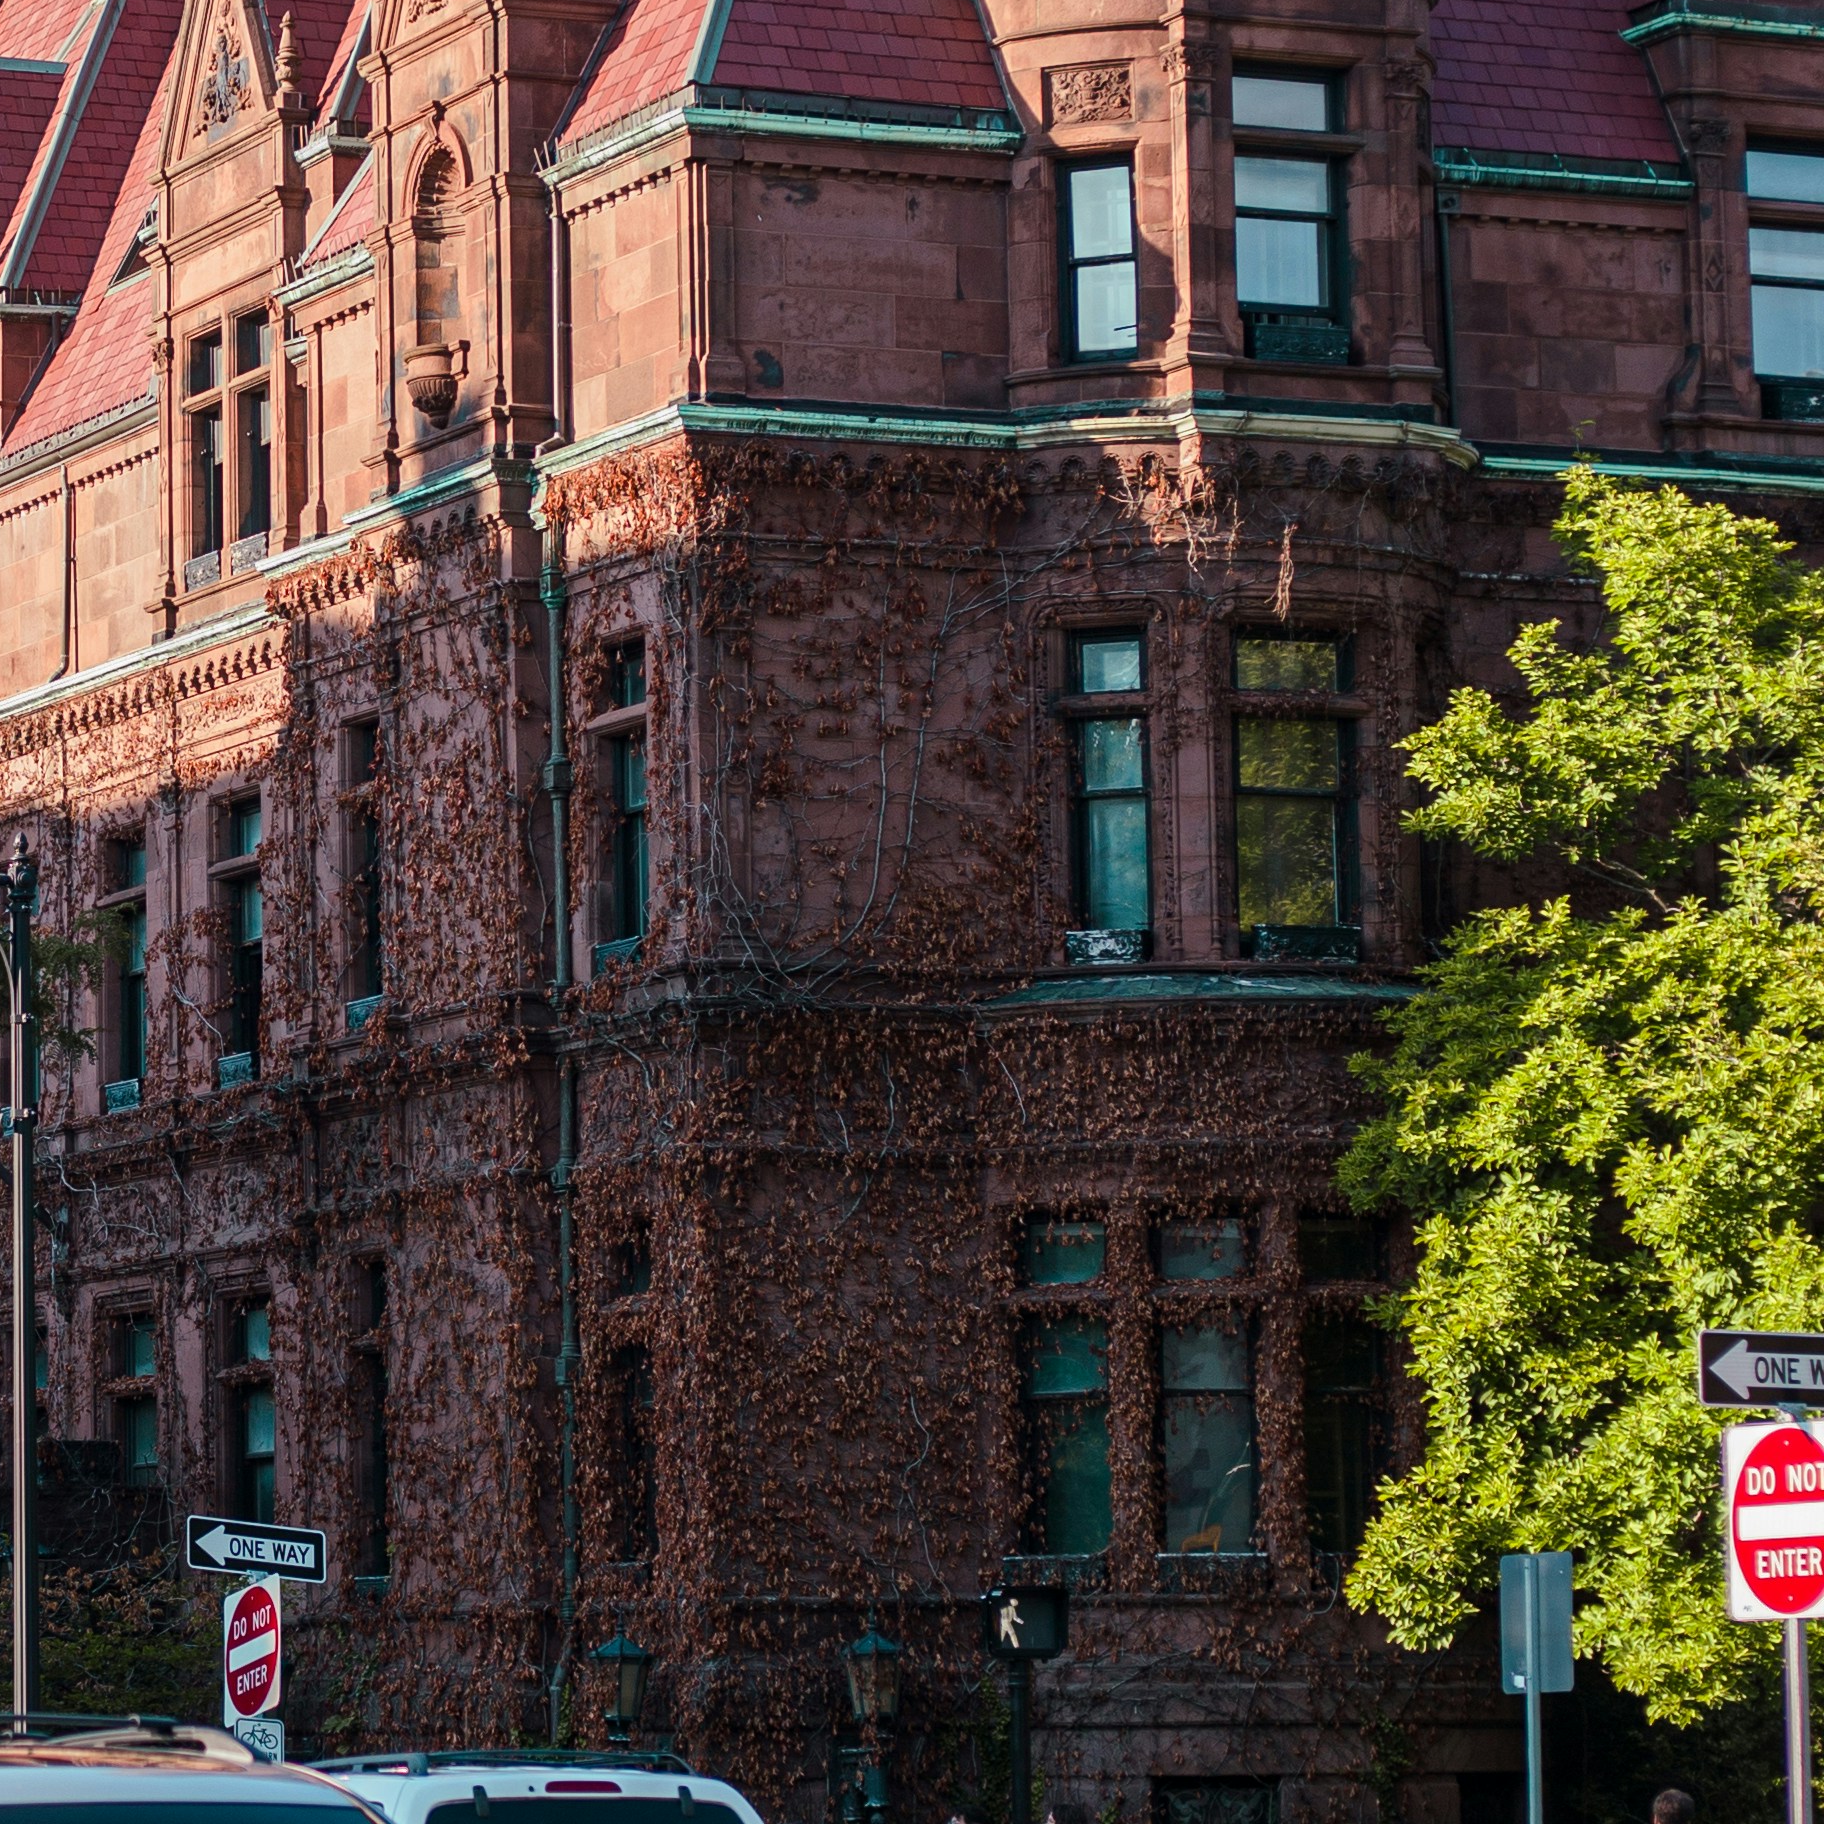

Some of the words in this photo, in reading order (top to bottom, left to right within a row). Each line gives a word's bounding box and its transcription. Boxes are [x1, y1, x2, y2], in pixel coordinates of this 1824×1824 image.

[1755, 1356, 1801, 1384] ONE
[1746, 1465, 1776, 1496] DO
[229, 1537, 265, 1559] ONE
[272, 1542, 310, 1564] WAY
[1755, 1546, 1824, 1579] ENTER
[233, 1616, 247, 1641] DO
[252, 1604, 271, 1631] NOT
[237, 1664, 268, 1696] ENTER
